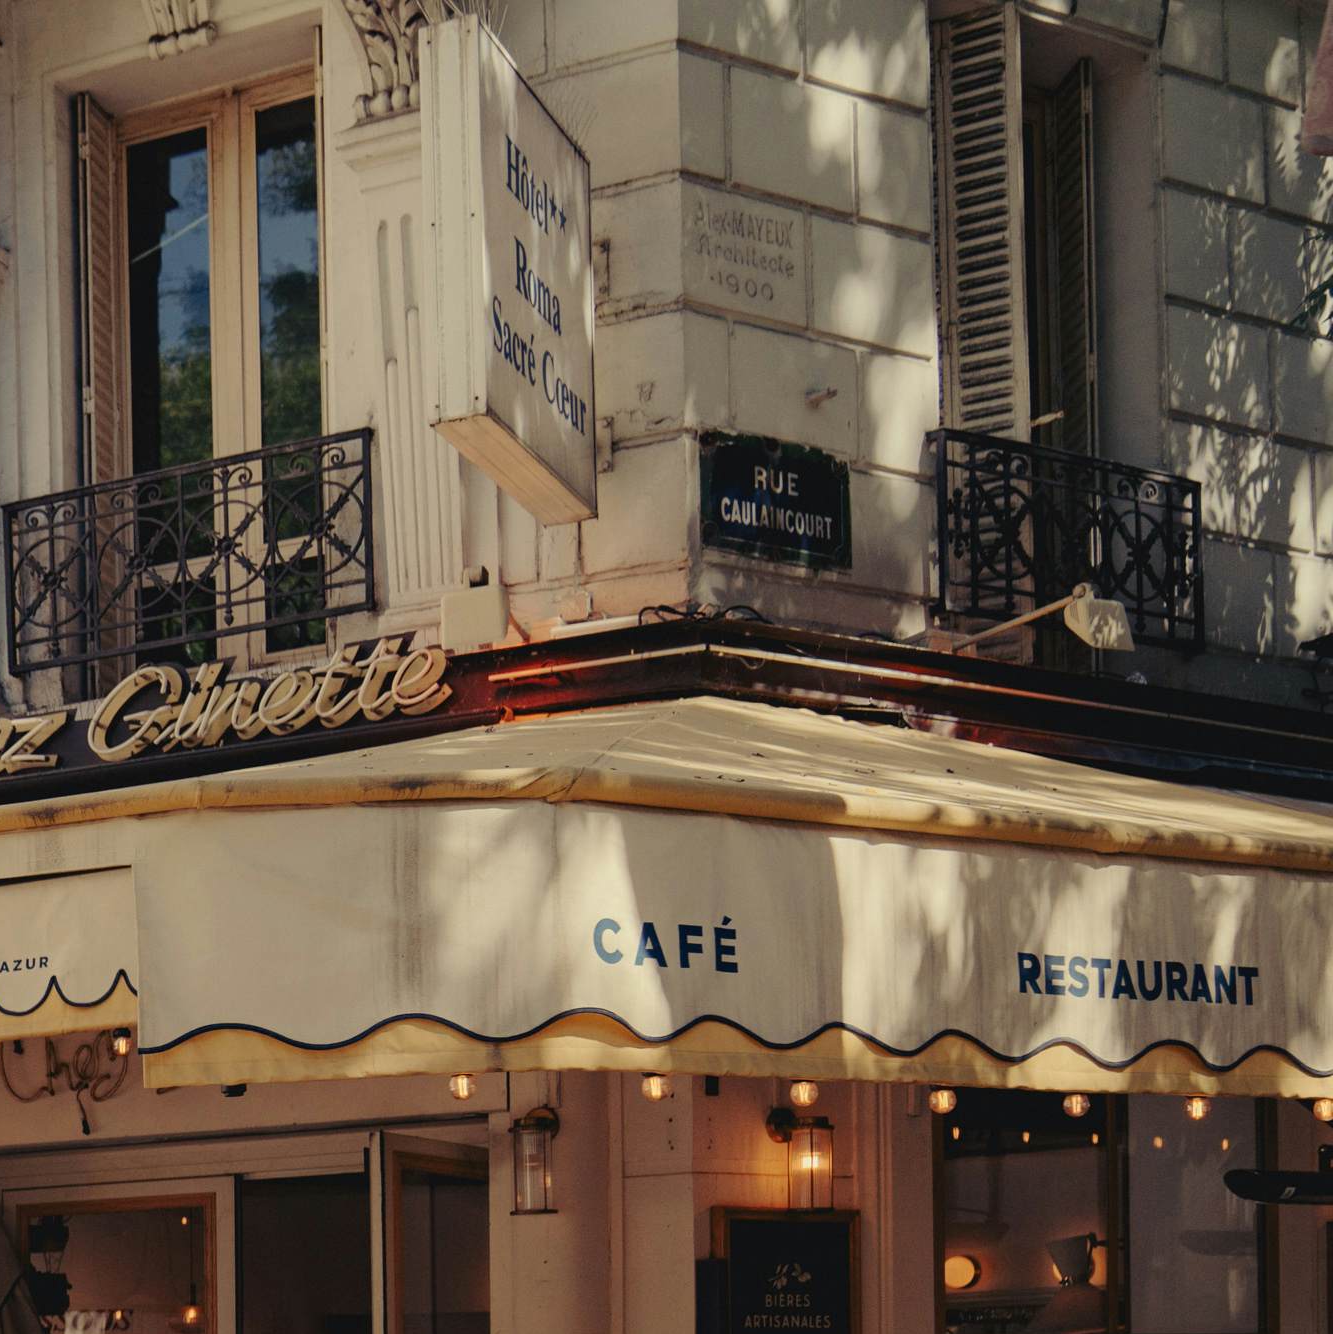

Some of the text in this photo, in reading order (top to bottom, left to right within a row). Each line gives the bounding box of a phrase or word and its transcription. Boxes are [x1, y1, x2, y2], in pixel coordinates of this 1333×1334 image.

[506, 134, 549, 236] Hôtel
[514, 236, 562, 336] Roma
[695, 233, 794, 277] Architecte
[493, 295, 587, 436] Sacré Cœur
[721, 496, 833, 539] CAULAINCOURT
[754, 466, 799, 496] RUE
[86, 630, 454, 762] Ginette
[592, 916, 1259, 1006] CAFÉ RESTAURANT
[744, 1315, 832, 1329] ARTISANALES
